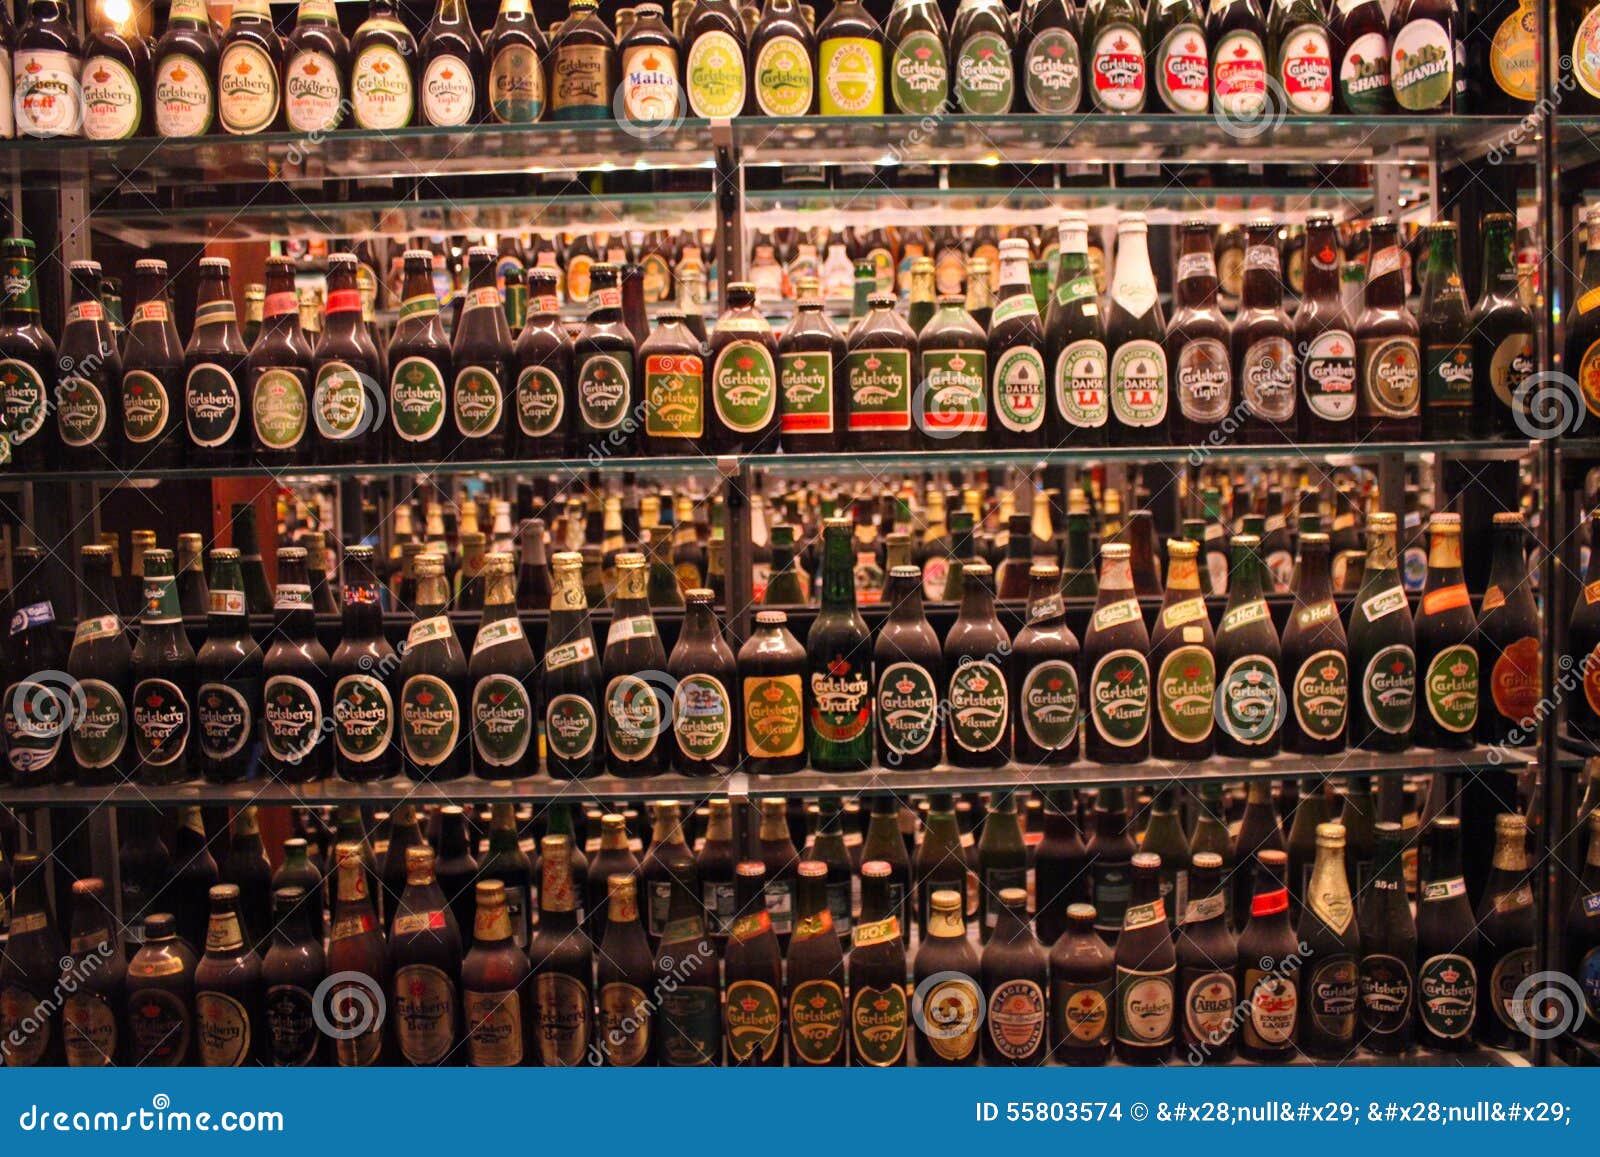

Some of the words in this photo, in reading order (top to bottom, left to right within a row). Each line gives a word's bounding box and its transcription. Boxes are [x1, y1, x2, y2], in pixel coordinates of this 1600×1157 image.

[897, 58, 945, 79] Carlsberg
[1029, 56, 1078, 77] Carlsberg
[1096, 55, 1142, 74] Carlsberg
[630, 72, 673, 86] Malta
[1042, 75, 1071, 89] Light
[1108, 72, 1136, 86] Light
[1299, 75, 1325, 89] Light
[1395, 58, 1448, 91] SHANDY
[222, 75, 270, 94] Carlsberg
[357, 74, 408, 95] Carlsberg
[429, 80, 468, 96] Carlsberg
[909, 77, 938, 92] Light
[84, 87, 131, 104] Carlsberg
[157, 85, 207, 104] Carlsberg
[719, 368, 771, 390] Carlsberg
[782, 369, 825, 390] Carlsberg
[851, 370, 902, 391] Carlsberg
[928, 367, 982, 391] Carlsberg
[1072, 378, 1104, 389] DANSK
[1124, 378, 1158, 389] DANSK
[1179, 368, 1228, 388] Carlsberg
[395, 384, 441, 402] Carlsberg
[582, 380, 623, 397] Carlsberg
[1006, 383, 1040, 394] DANSK
[1193, 386, 1221, 400] Light
[123, 393, 161, 411] Carlsberg
[189, 390, 234, 409] Carlsberg
[457, 390, 495, 406] Carlsberg
[520, 390, 556, 405] Carlsberg
[589, 398, 618, 411] Lager
[732, 395, 761, 406] Beer
[789, 392, 813, 404] Beer
[860, 393, 884, 405] Beer
[1013, 395, 1033, 409] LA
[1078, 391, 1099, 405] LA
[1130, 391, 1152, 405] LA
[195, 409, 224, 423] Lager
[402, 402, 431, 416] Lager
[461, 407, 489, 420] Lager
[523, 406, 552, 419] Lager
[126, 411, 154, 424] Lager
[1236, 605, 1257, 620] Hof
[1310, 604, 1331, 619] Hof
[812, 672, 867, 696] Carlsberg
[1371, 672, 1415, 690] Carlsberg
[953, 688, 1004, 708] Carlsberg
[1028, 688, 1076, 706] Carlsberg
[1096, 681, 1148, 703] Carlsberg
[820, 696, 859, 713] Draft
[881, 690, 933, 711] Carlsberg
[1382, 696, 1411, 707] Pilsner
[1445, 700, 1475, 711] Pilsner
[73, 706, 119, 724] Carlsberg
[135, 706, 184, 725] Carlsberg
[200, 706, 241, 723] Carlsberg
[266, 703, 312, 723] Carlsberg
[334, 702, 385, 722] Carlsberg
[404, 702, 452, 722] Carlsberg
[477, 703, 524, 721] Carlsberg
[1039, 713, 1071, 724] Pilsner
[1108, 706, 1145, 720] Pilsner
[1175, 705, 1210, 717] Pilsner
[1308, 706, 1343, 717] Pilsner
[488, 722, 514, 734] Beer
[552, 714, 589, 731] Carlsberg
[677, 716, 724, 734] Carlsberg
[890, 717, 927, 730] Pilsner
[960, 716, 998, 729] Pilsner
[81, 727, 108, 738] Beer
[144, 727, 172, 738] Beer
[206, 726, 230, 737] Beer
[274, 726, 300, 737] Beer
[346, 726, 375, 737] Beer
[413, 726, 442, 737] Beer
[689, 734, 714, 745] Beer
[860, 924, 888, 939] HOF
[1422, 976, 1474, 998] Carlsberg
[1430, 1004, 1469, 1016] Pilsner
[808, 1029, 832, 1040] HOF
[872, 1031, 896, 1042] HOF
